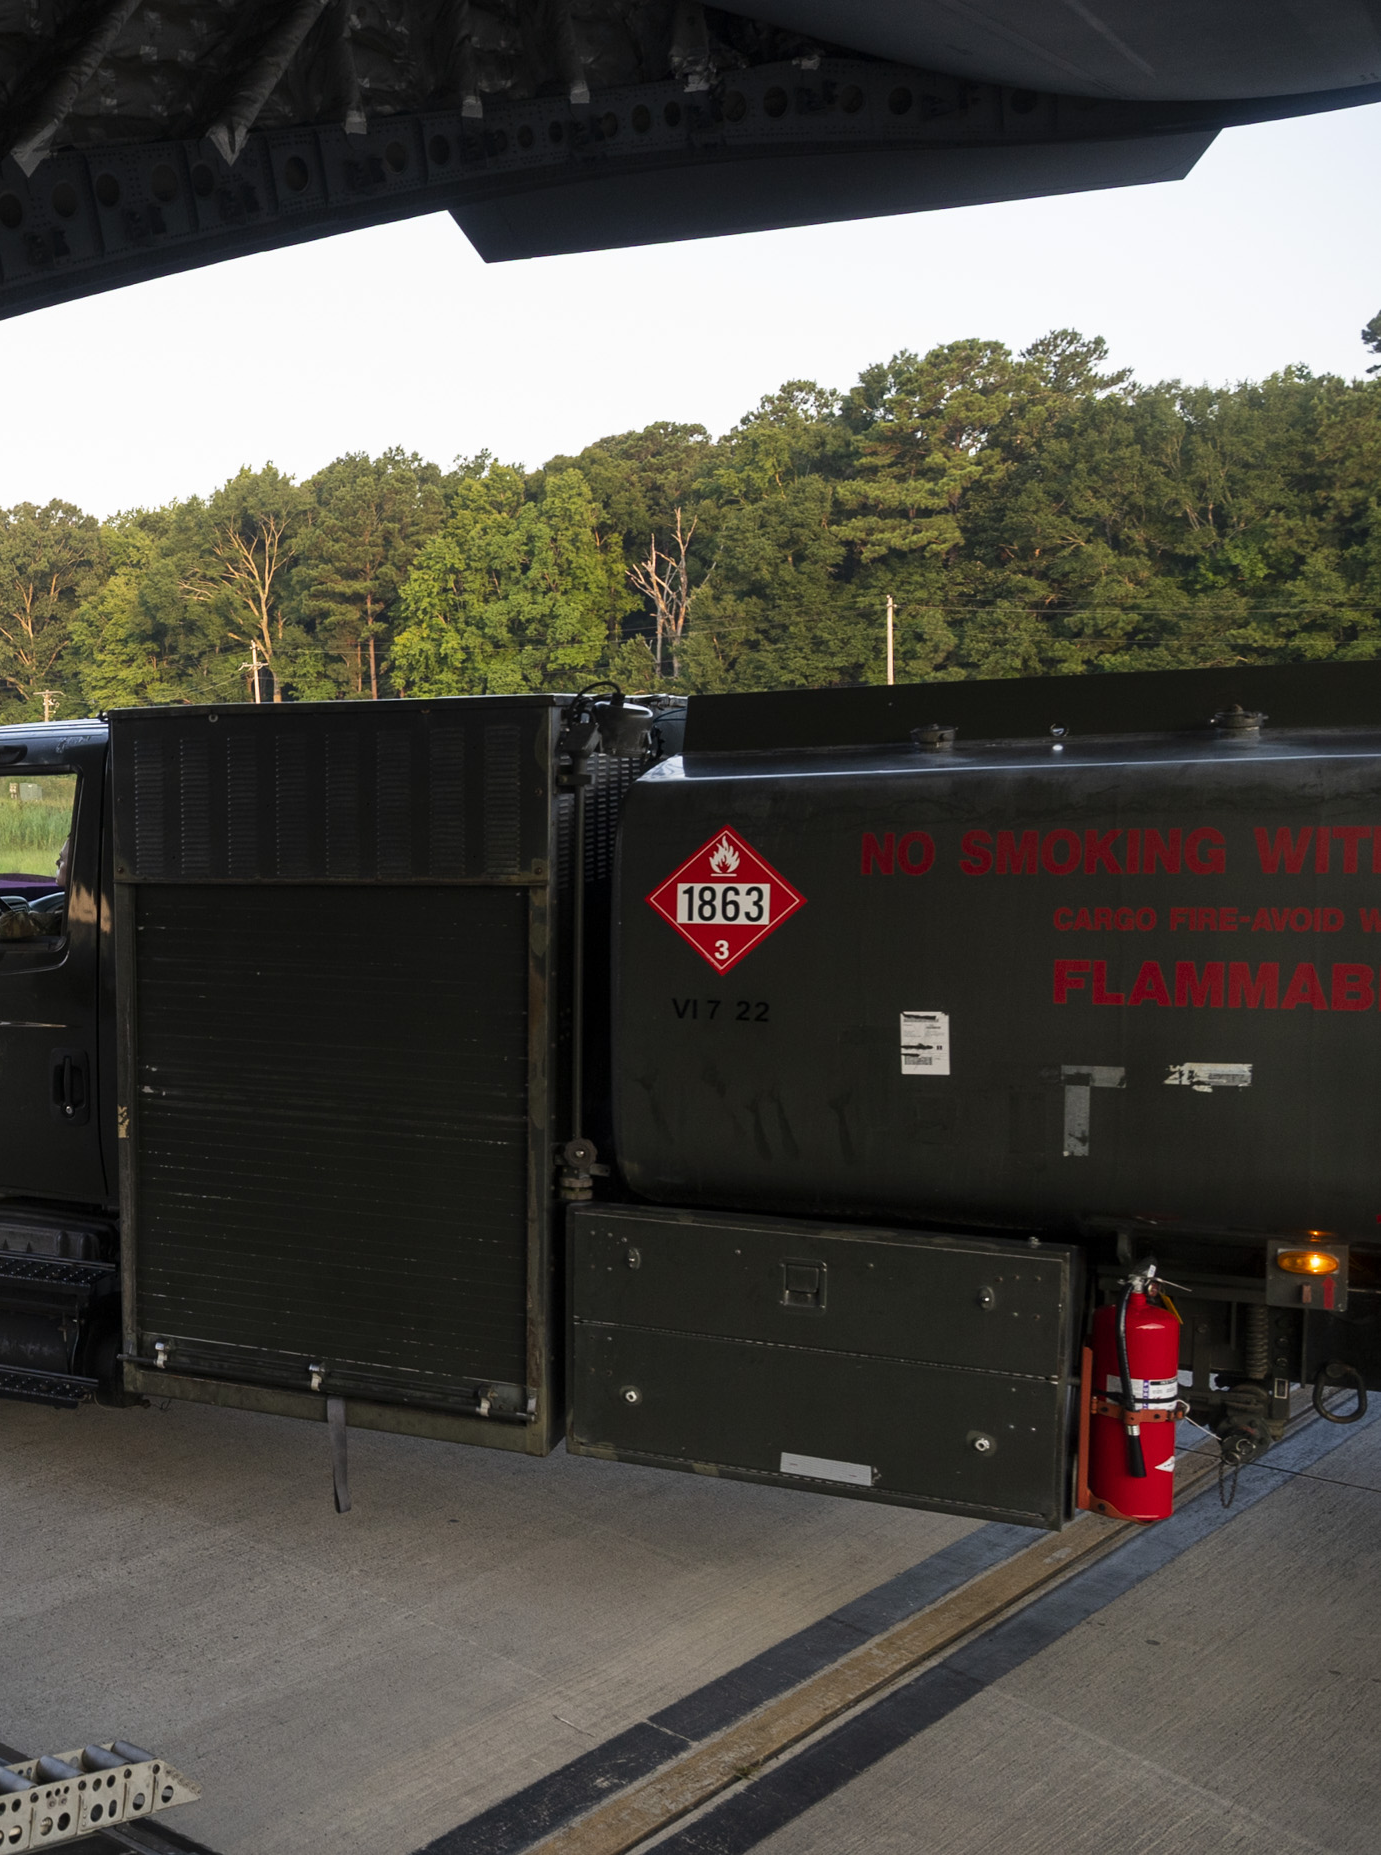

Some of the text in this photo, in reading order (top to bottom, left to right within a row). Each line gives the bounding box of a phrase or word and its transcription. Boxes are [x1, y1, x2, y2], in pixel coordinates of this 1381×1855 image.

[861, 825, 1381, 876] NO SMOKING WIT
[682, 885, 764, 922] 1863
[1053, 907, 1157, 931] CARGO
[1169, 907, 1345, 932] FIRE-AVOID
[714, 939, 730, 960] 3
[1053, 960, 1381, 1010] FLAMMAB
[735, 1001, 770, 1022] 22
